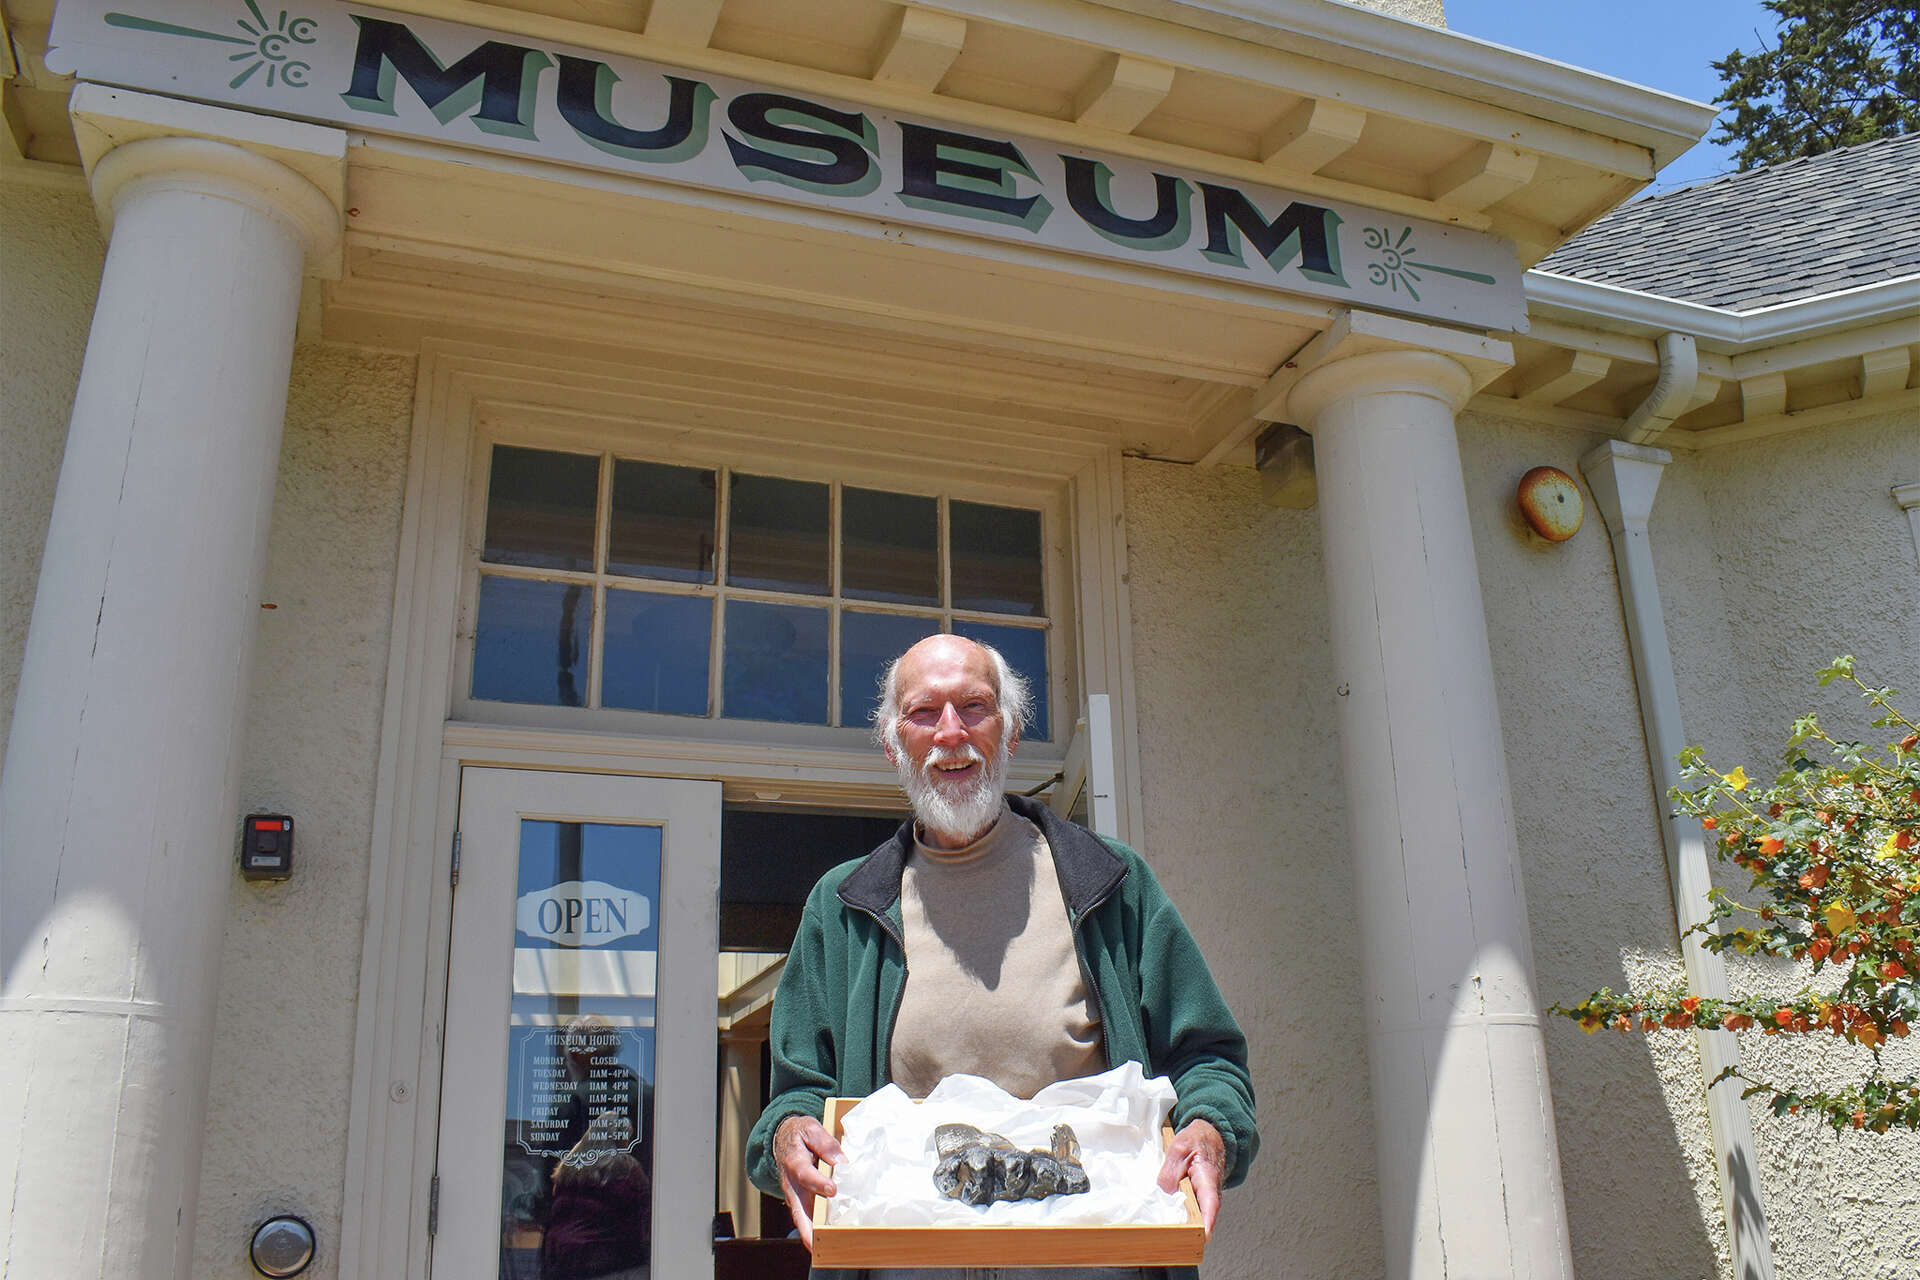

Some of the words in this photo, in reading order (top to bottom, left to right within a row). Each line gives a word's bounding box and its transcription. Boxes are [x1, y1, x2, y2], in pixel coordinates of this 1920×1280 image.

[341, 16, 1351, 288] MUSEUM
[538, 898, 628, 934] OPEN
[545, 1034, 586, 1046] MUSEUM
[588, 1034, 622, 1046] HOURS
[533, 1056, 565, 1065] MONDAY
[590, 1056, 618, 1065] CLOSED
[533, 1068, 566, 1078] TUESDAY
[533, 1081, 578, 1091] WEDNESDAY
[532, 1093, 572, 1103] THURSDAY
[531, 1106, 560, 1116] FRIDAY
[530, 1119, 570, 1129] SATURDAY
[530, 1132, 560, 1141] SUNDAY
